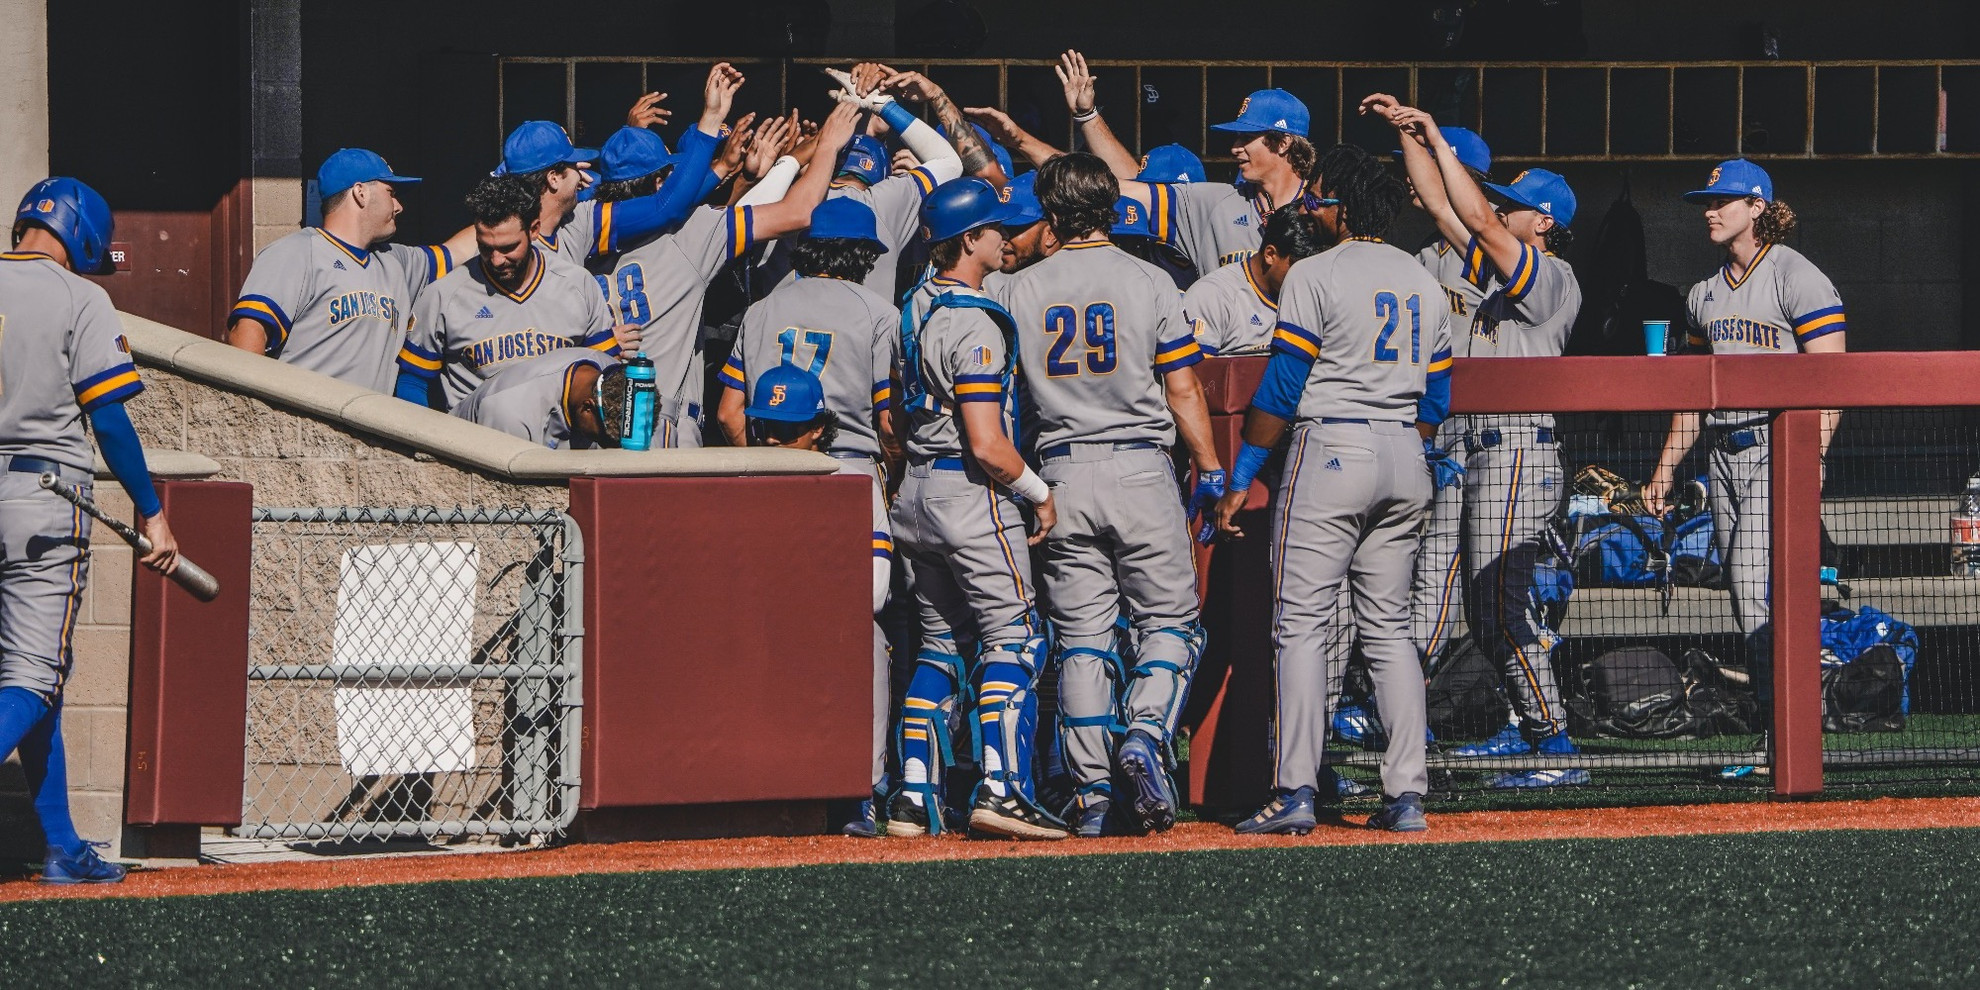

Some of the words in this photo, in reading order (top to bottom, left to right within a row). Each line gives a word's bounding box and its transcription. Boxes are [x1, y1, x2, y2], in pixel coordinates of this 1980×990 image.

[110, 251, 125, 262] ER
[329, 291, 360, 326] SAN
[1372, 289, 1422, 366] 21
[497, 327, 535, 363] JOSÉ
[776, 326, 835, 380] 17
[1043, 301, 1119, 379] 29
[1736, 318, 1781, 351] STATE
[623, 378, 634, 437] POWERADE
